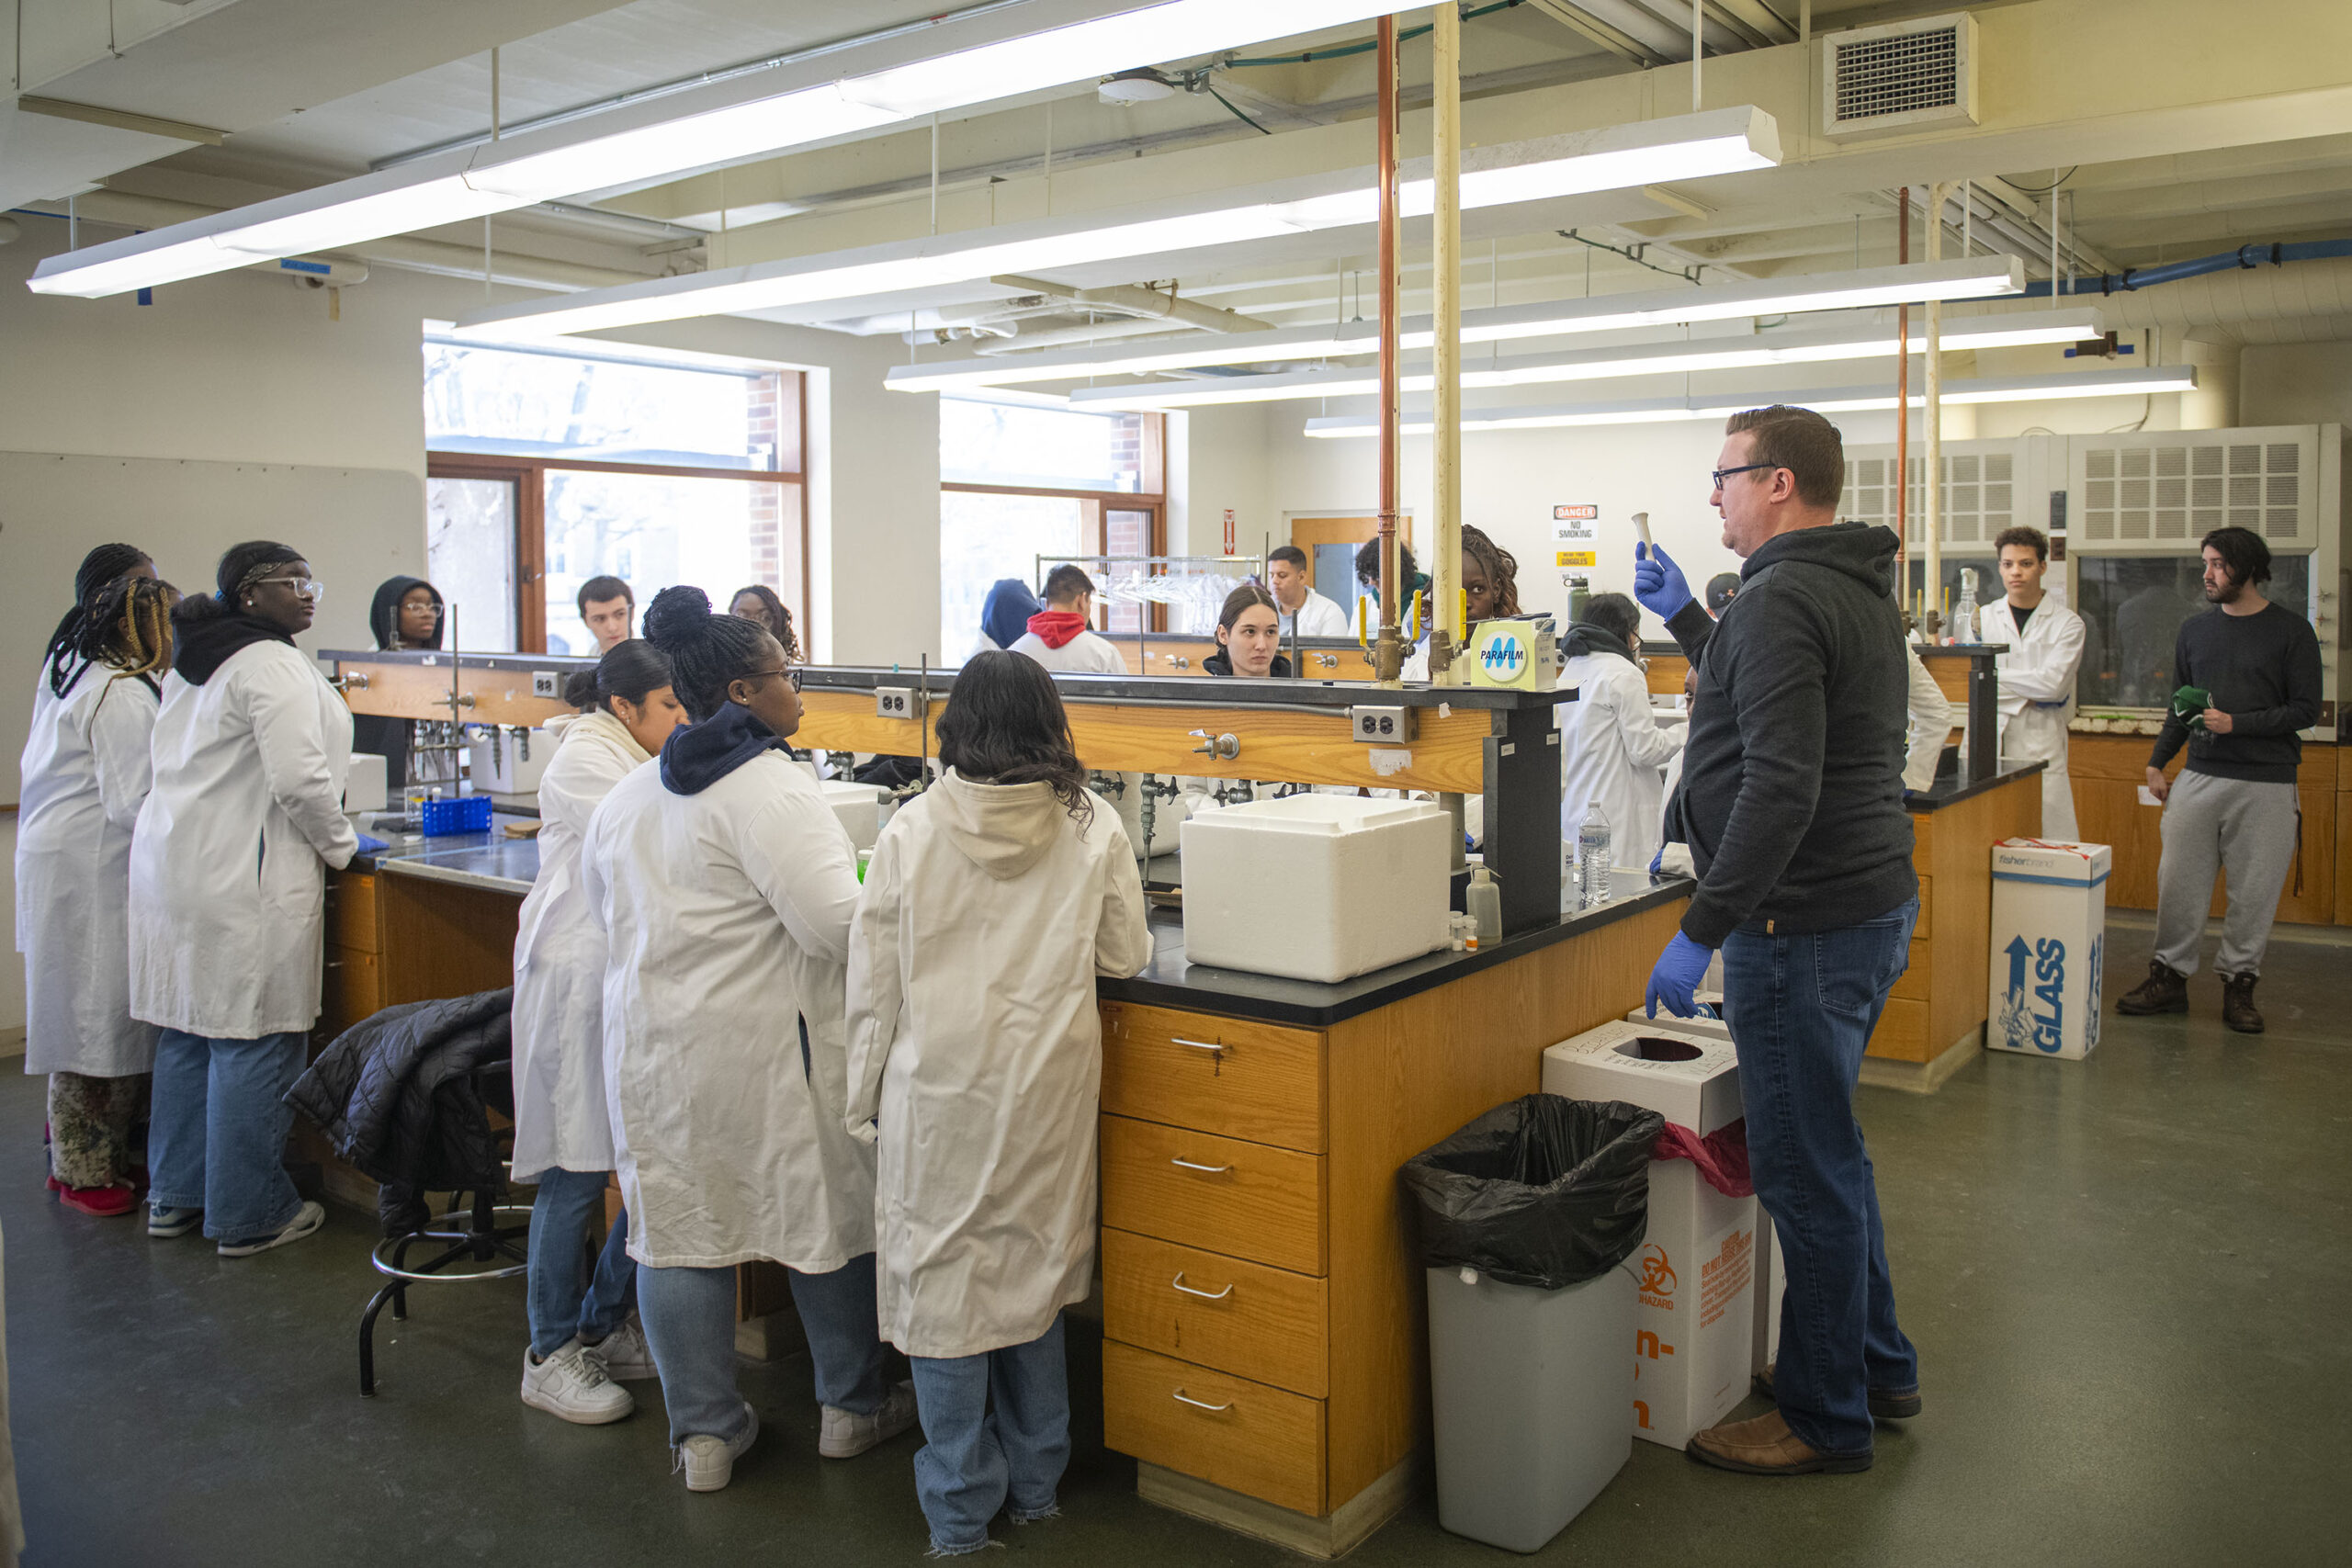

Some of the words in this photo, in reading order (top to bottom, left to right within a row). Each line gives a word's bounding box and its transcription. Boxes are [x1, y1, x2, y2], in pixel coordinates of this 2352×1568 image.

[1557, 507, 1593, 517] DANGER
[1570, 521, 1581, 529] NO
[1558, 530, 1592, 538] SMOKING
[1480, 649, 1523, 660] PARAFILM
[1999, 854, 2054, 869] fisherbrand
[2033, 937, 2066, 1054] GLASS
